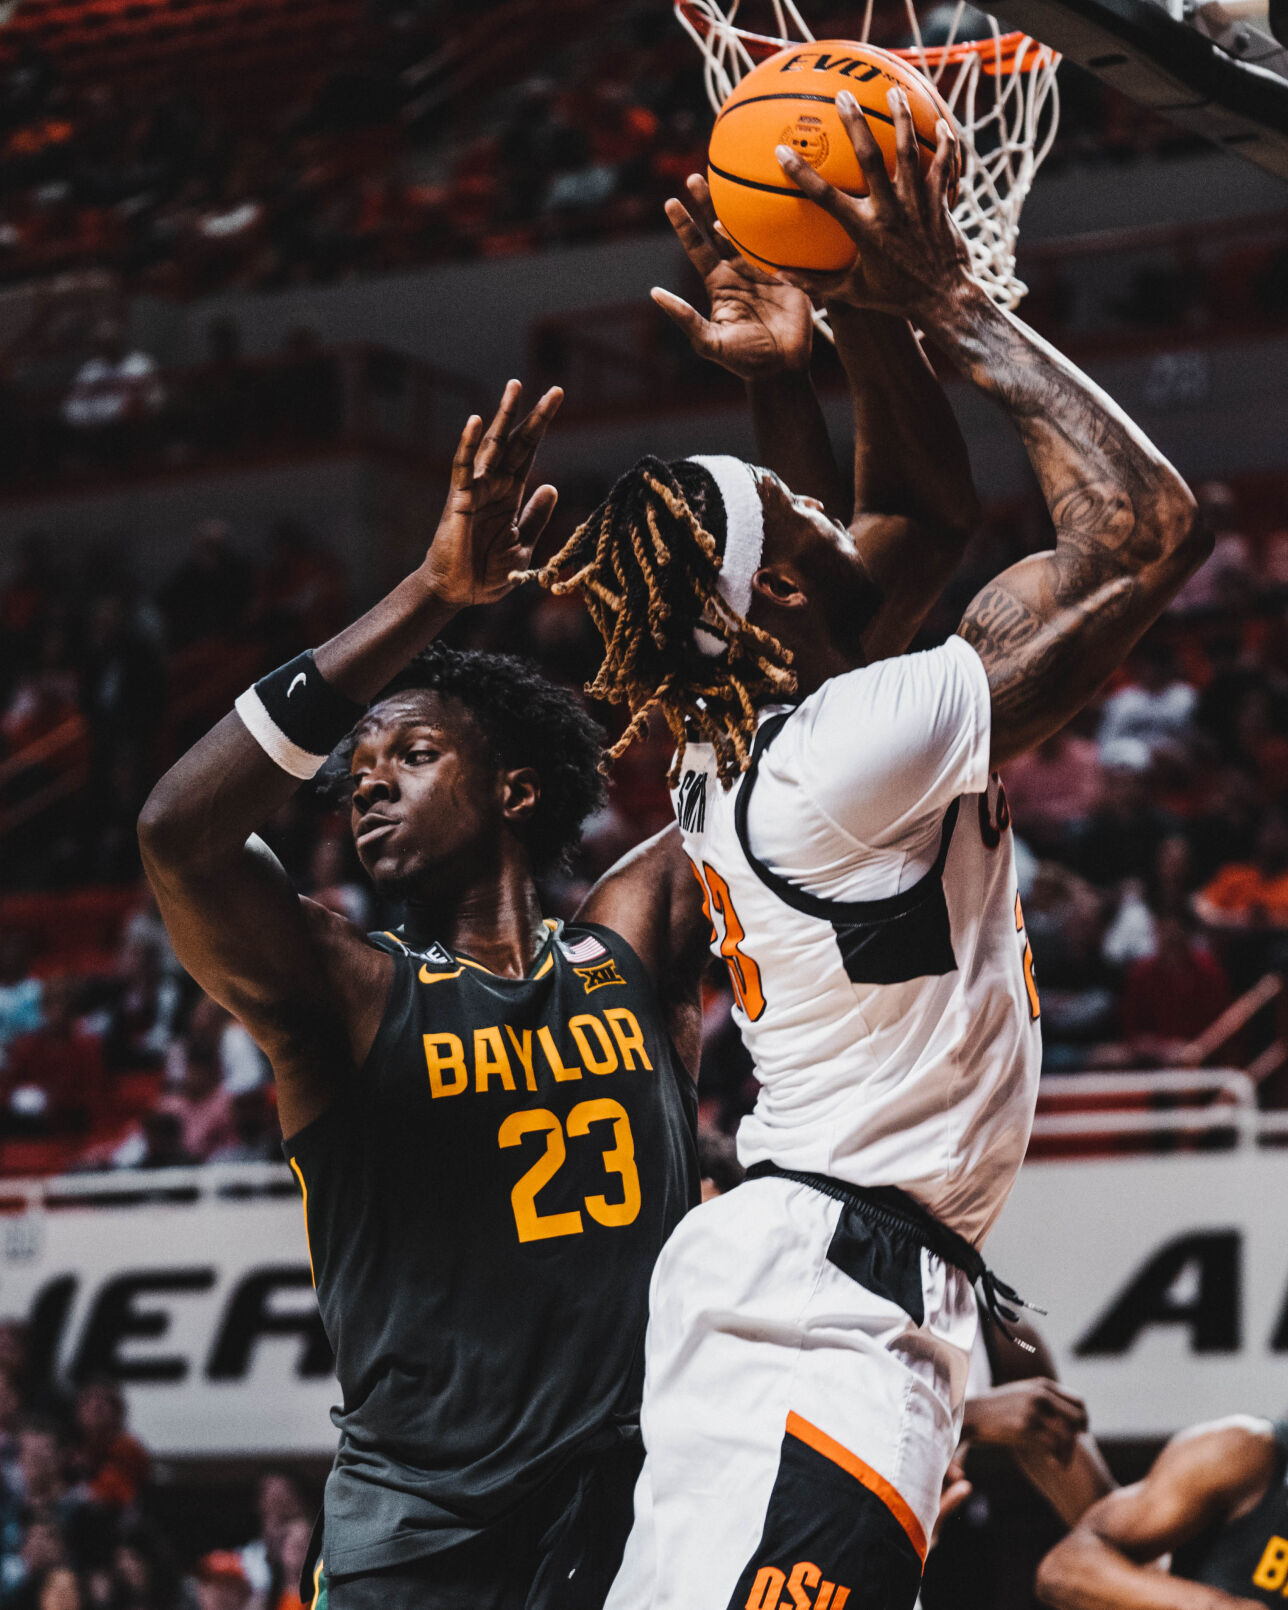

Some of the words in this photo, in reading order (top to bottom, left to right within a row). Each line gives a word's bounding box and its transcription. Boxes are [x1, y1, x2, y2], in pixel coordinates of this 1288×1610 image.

[781, 53, 882, 82] EVO
[423, 1007, 653, 1099] BAYLOR
[497, 1097, 642, 1244] 23
